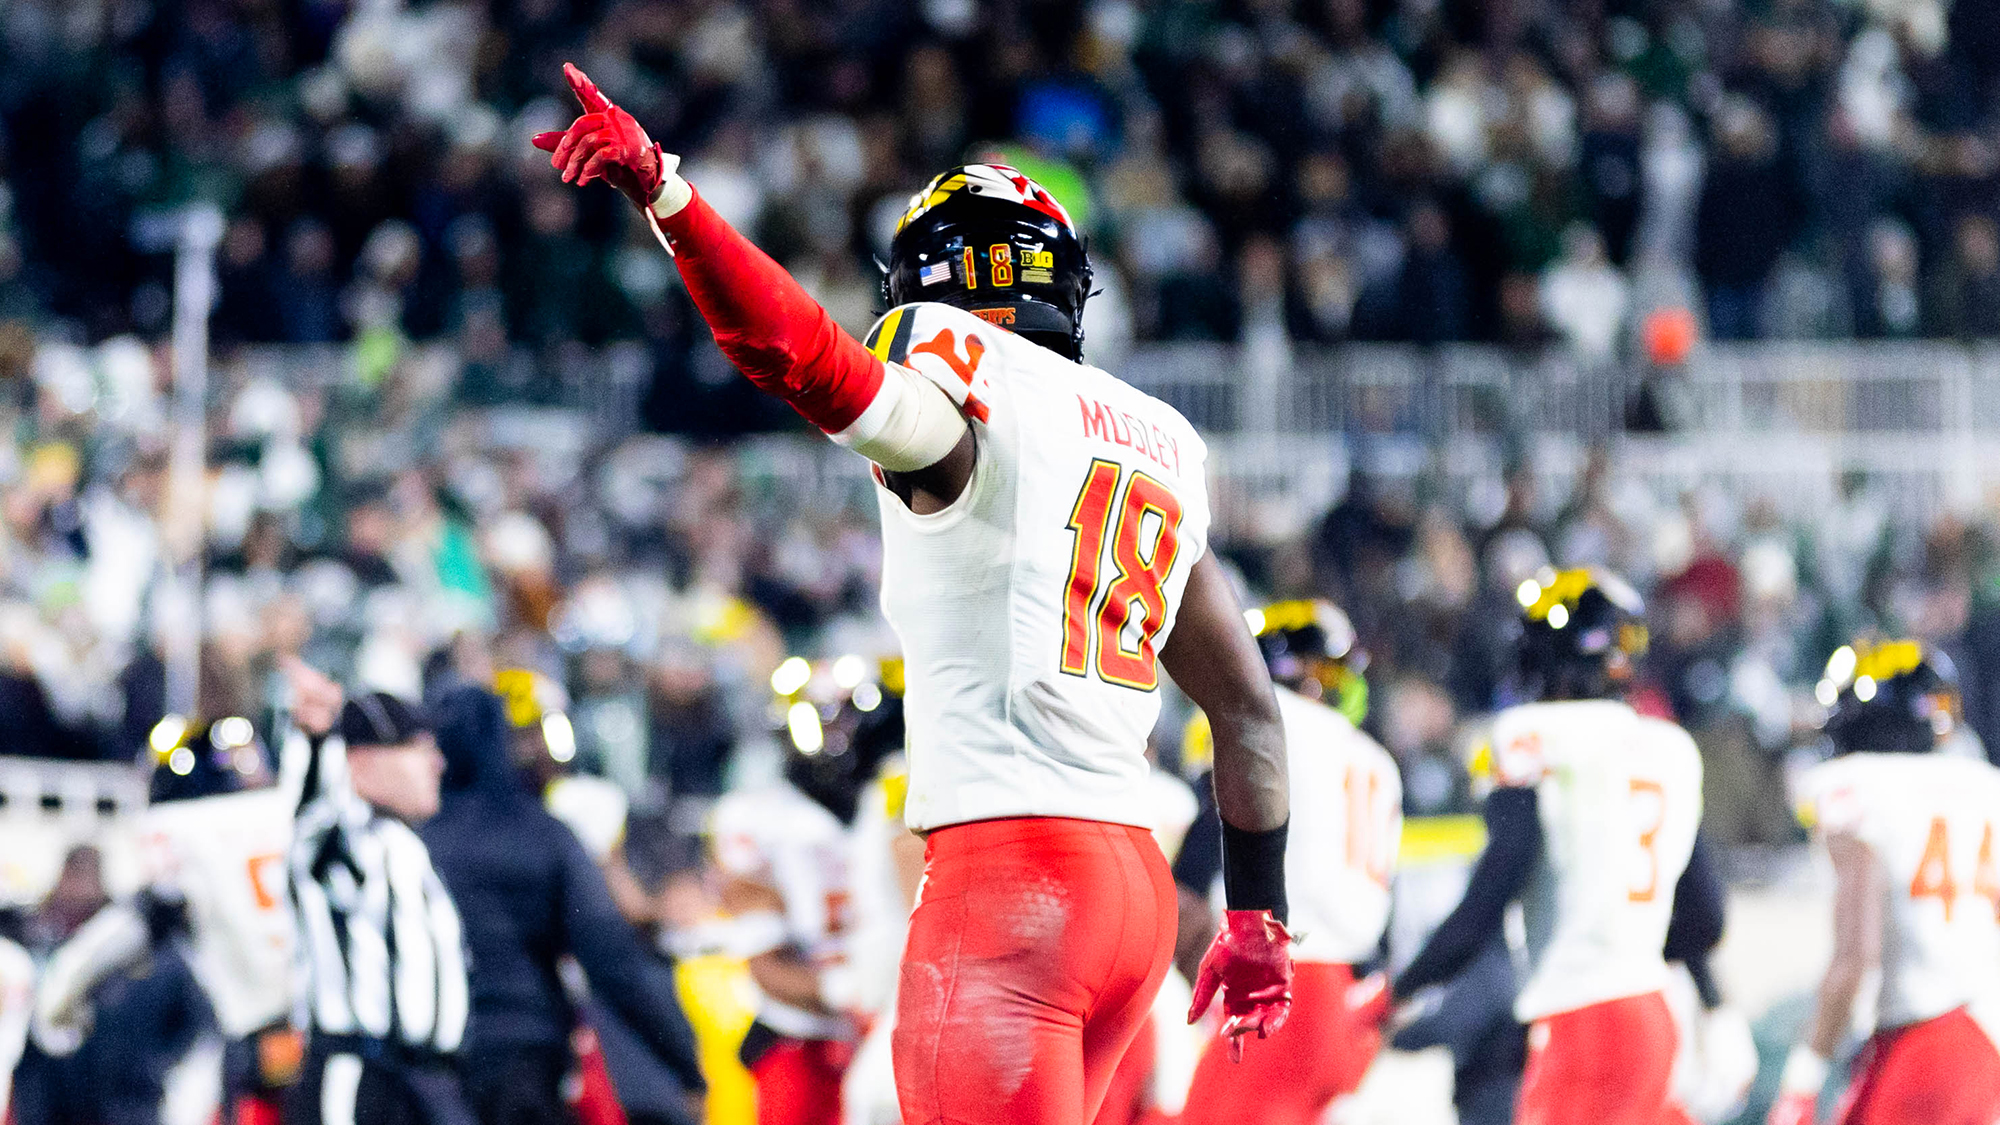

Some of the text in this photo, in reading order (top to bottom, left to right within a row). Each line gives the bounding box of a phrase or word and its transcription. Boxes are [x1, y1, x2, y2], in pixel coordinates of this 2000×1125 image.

[963, 243, 1013, 289] 18
[1076, 394, 1179, 477] MOSLEY
[1060, 457, 1183, 692] 18
[1628, 778, 1664, 903] 3
